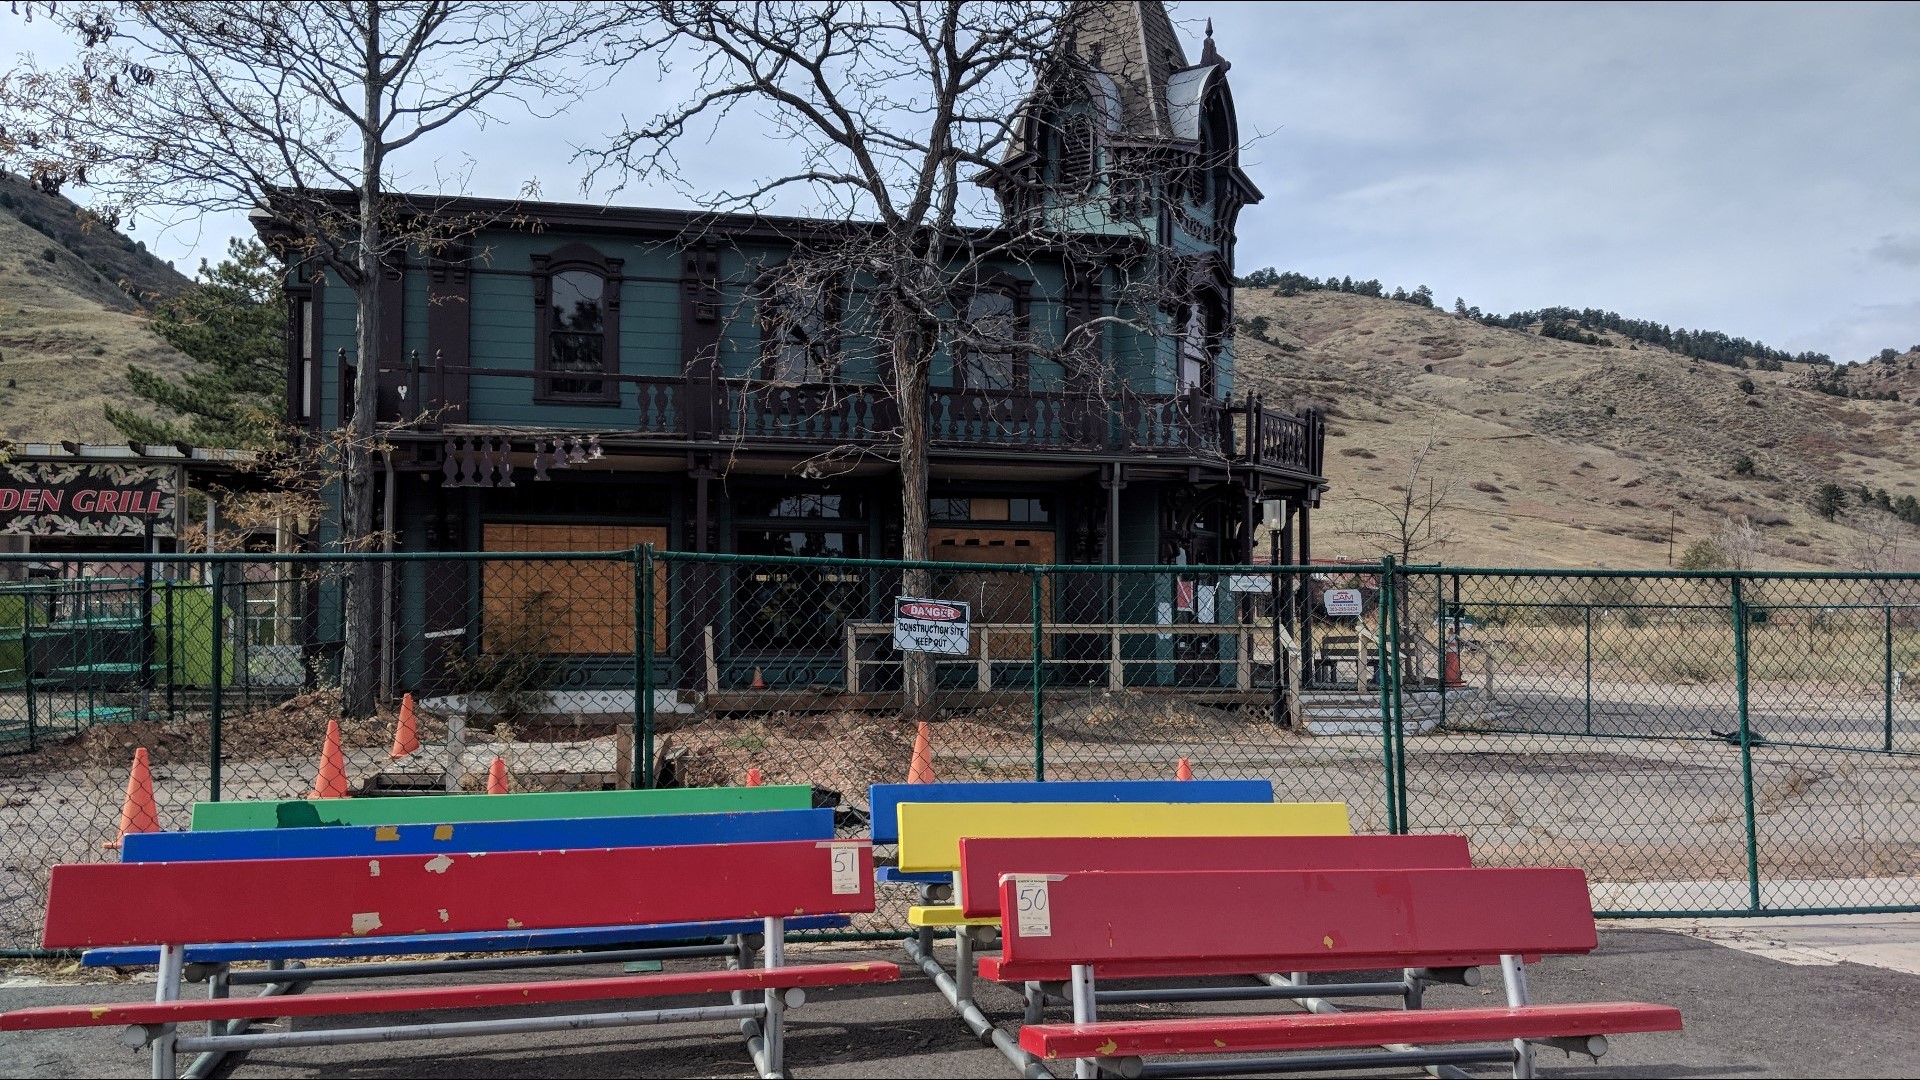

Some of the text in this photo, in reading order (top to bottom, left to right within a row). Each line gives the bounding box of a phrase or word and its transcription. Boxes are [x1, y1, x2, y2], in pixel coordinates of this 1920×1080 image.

[71, 489, 164, 514] GRILL
[910, 605, 955, 618] DANGER
[899, 623, 964, 636] CONSTRUCTION SITE
[915, 637, 947, 648] KEEP OUT
[832, 852, 854, 873] 51
[1018, 888, 1047, 911] 50
